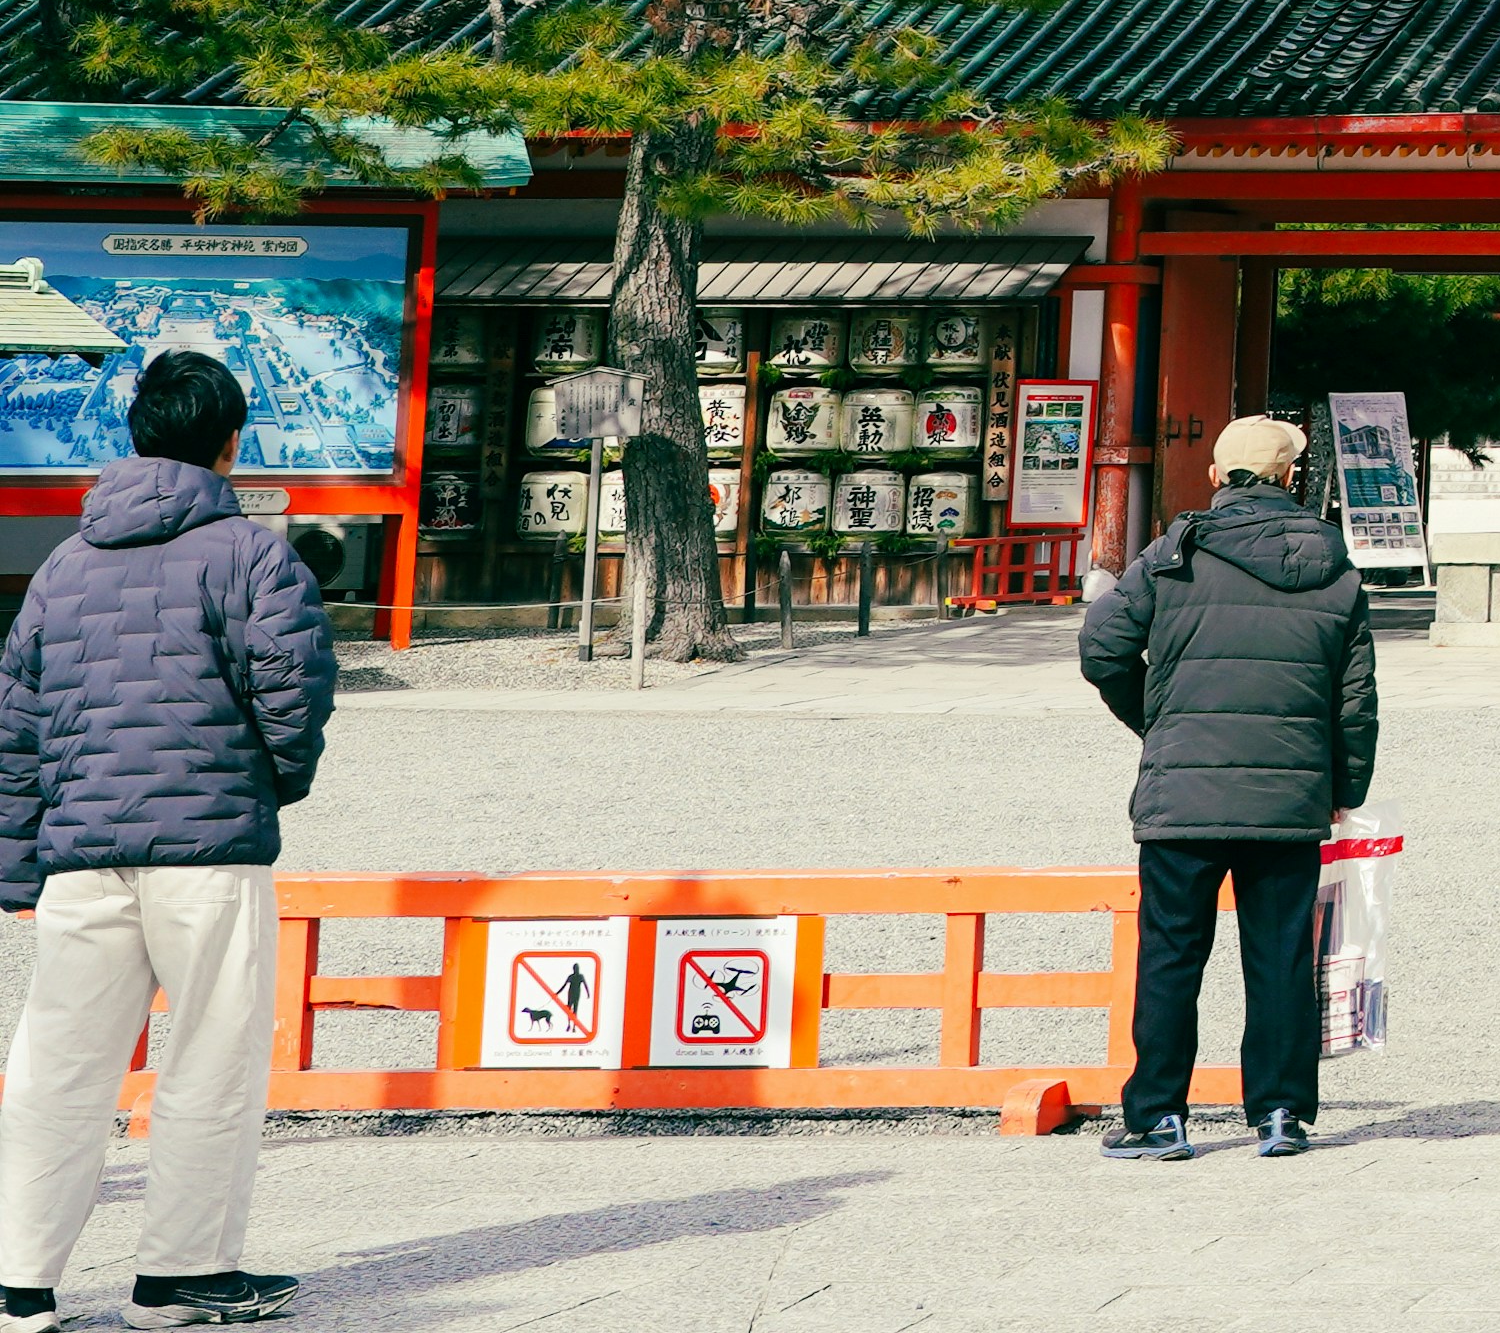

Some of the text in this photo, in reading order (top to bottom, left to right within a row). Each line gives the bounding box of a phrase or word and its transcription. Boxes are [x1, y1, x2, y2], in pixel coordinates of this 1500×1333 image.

[986, 374, 1010, 489] 伏見酒造組合
[847, 485, 877, 529] 神聖
[675, 1048, 697, 1056] drone
